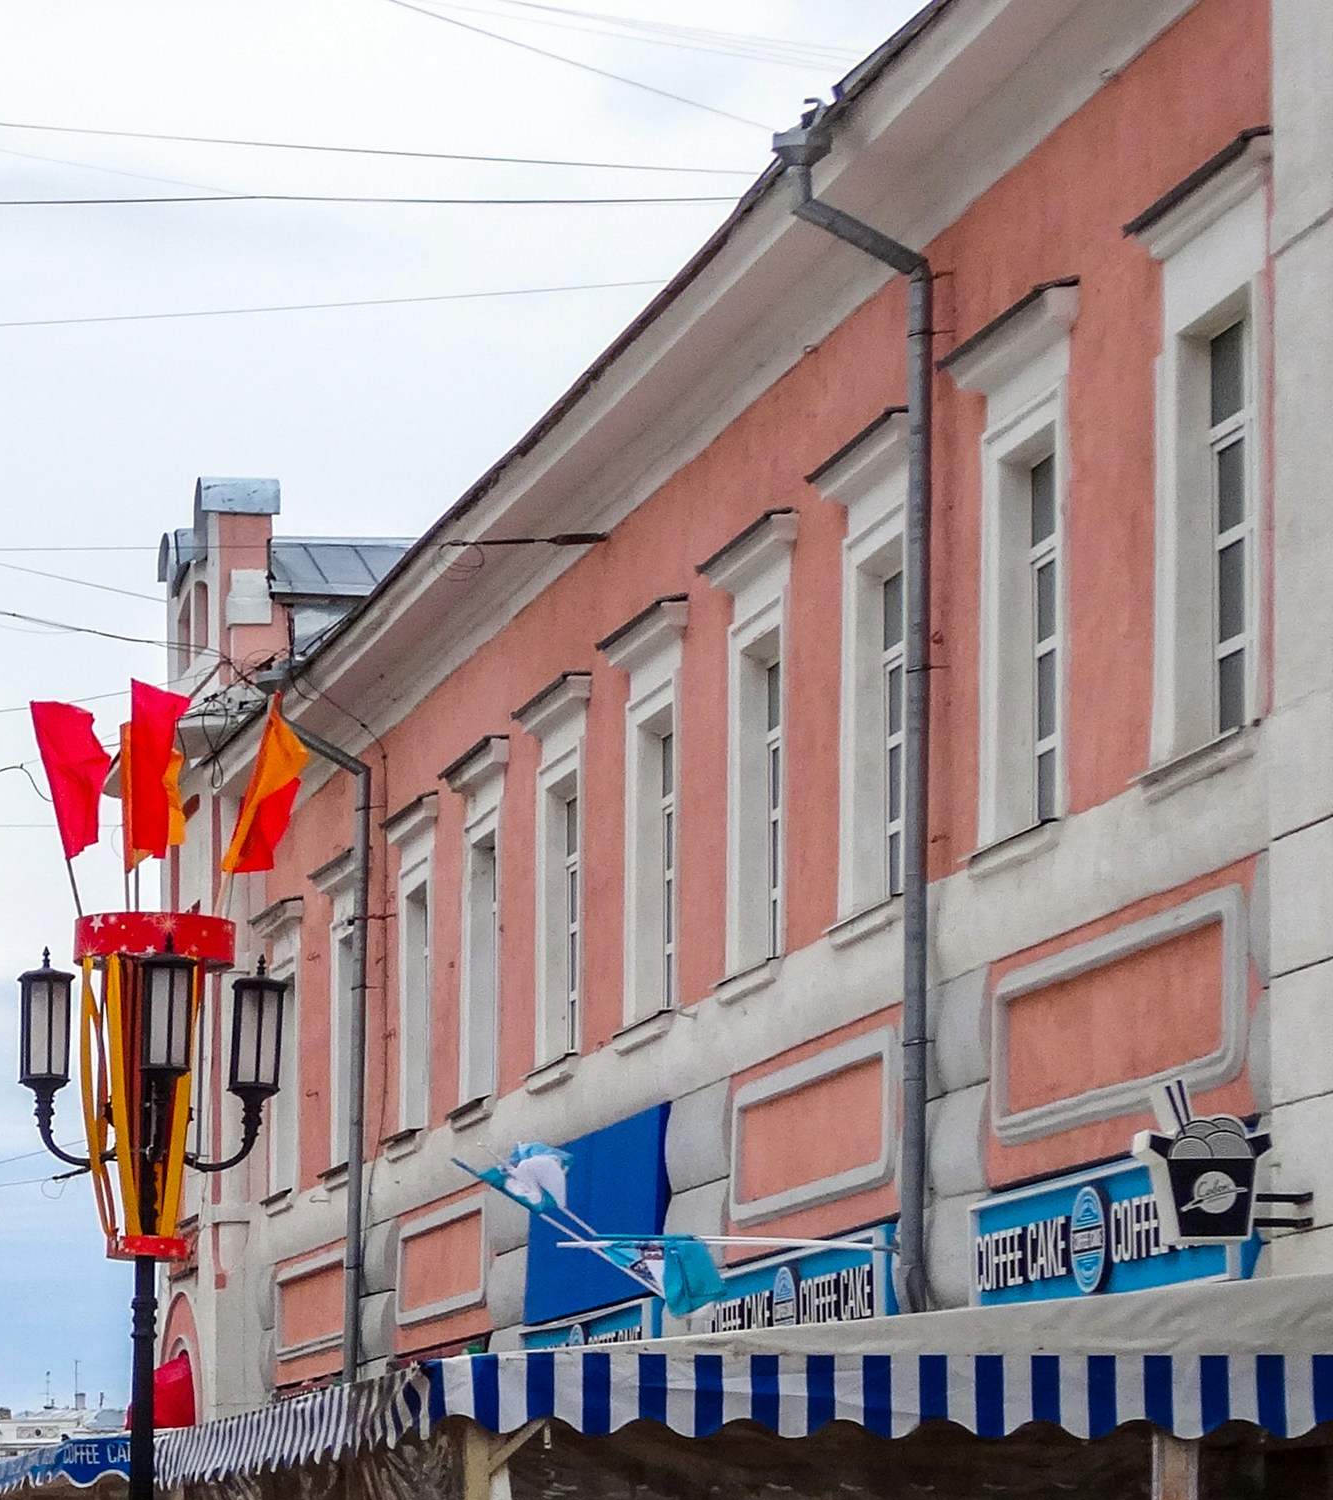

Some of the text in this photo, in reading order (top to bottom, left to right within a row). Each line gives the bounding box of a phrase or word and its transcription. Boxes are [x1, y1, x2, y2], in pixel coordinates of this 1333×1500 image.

[976, 1193, 1169, 1291] COFFEE CAKE COFFE
[799, 1273, 838, 1325] COFFEE
[841, 1264, 872, 1320] CAKE
[107, 1442, 131, 1463] CA
